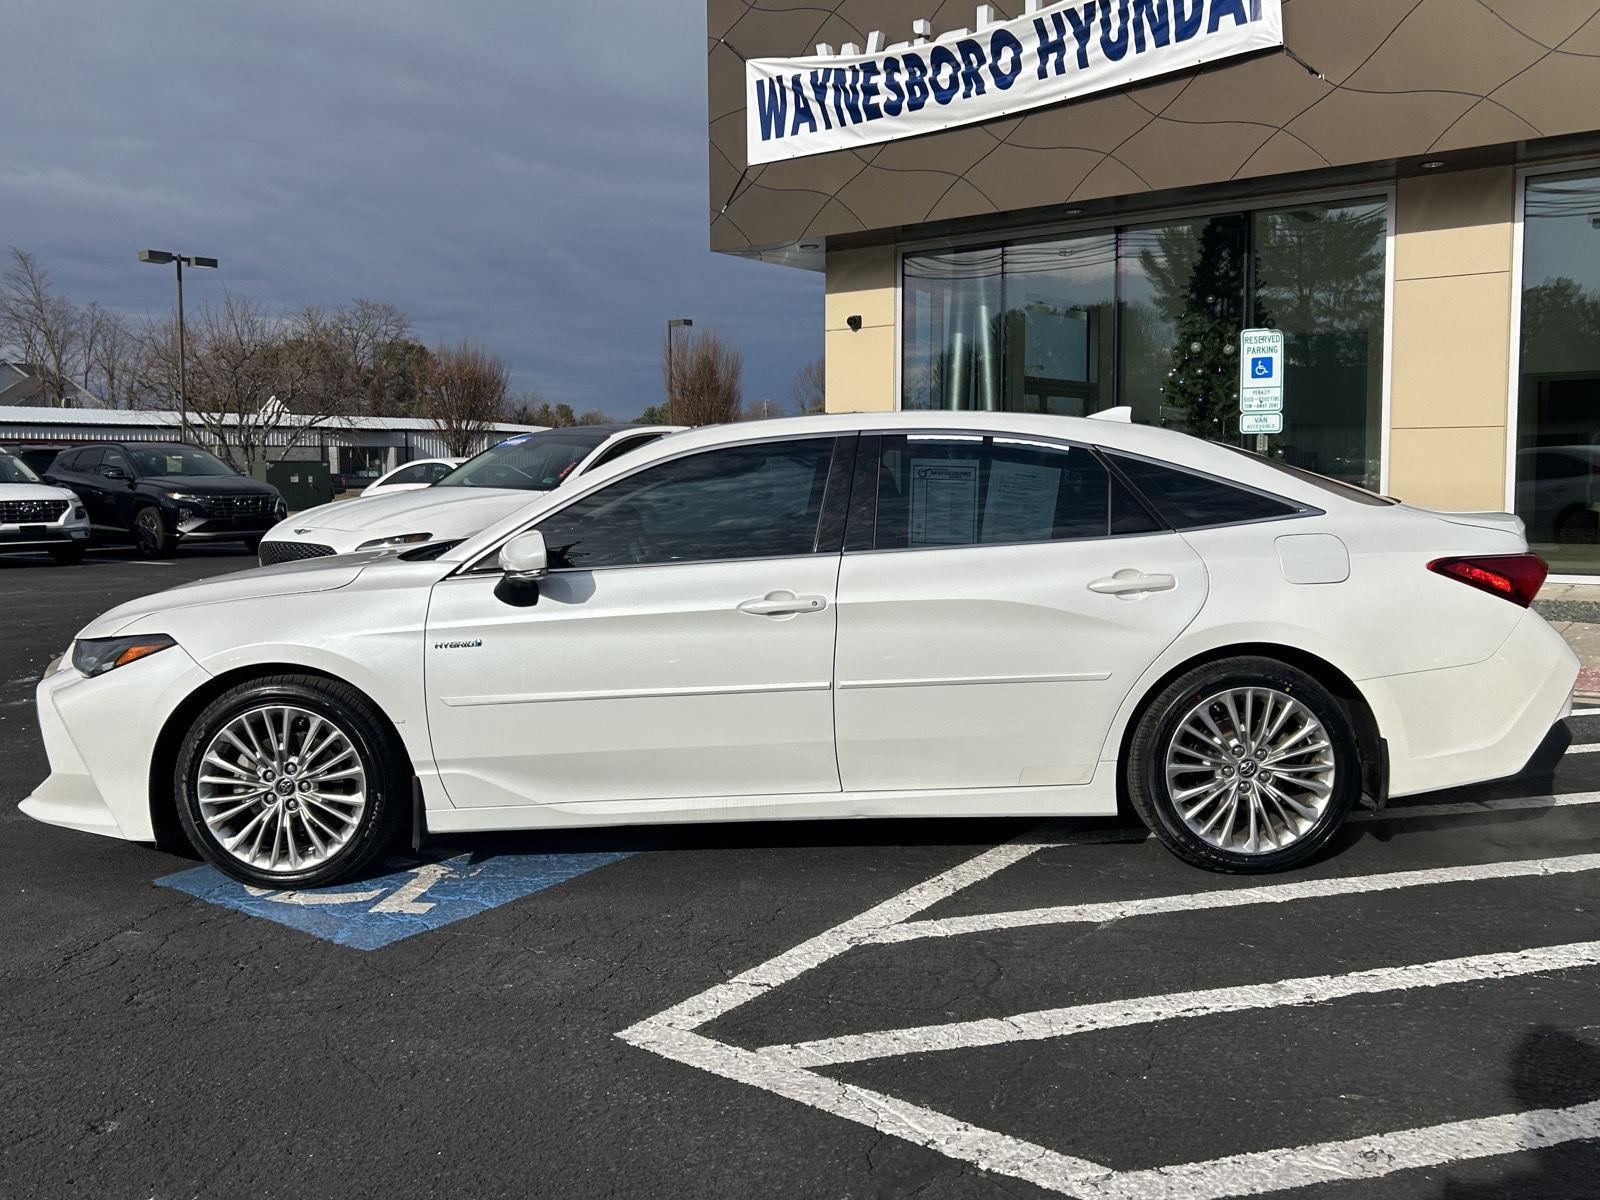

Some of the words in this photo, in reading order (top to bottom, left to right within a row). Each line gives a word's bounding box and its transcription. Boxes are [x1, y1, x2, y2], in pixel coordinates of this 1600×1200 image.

[756, 29, 1023, 141] WAYNESBORO
[1244, 335, 1281, 344] RESERVED
[1247, 346, 1278, 354] PARKING
[434, 641, 475, 649] HYBRID
